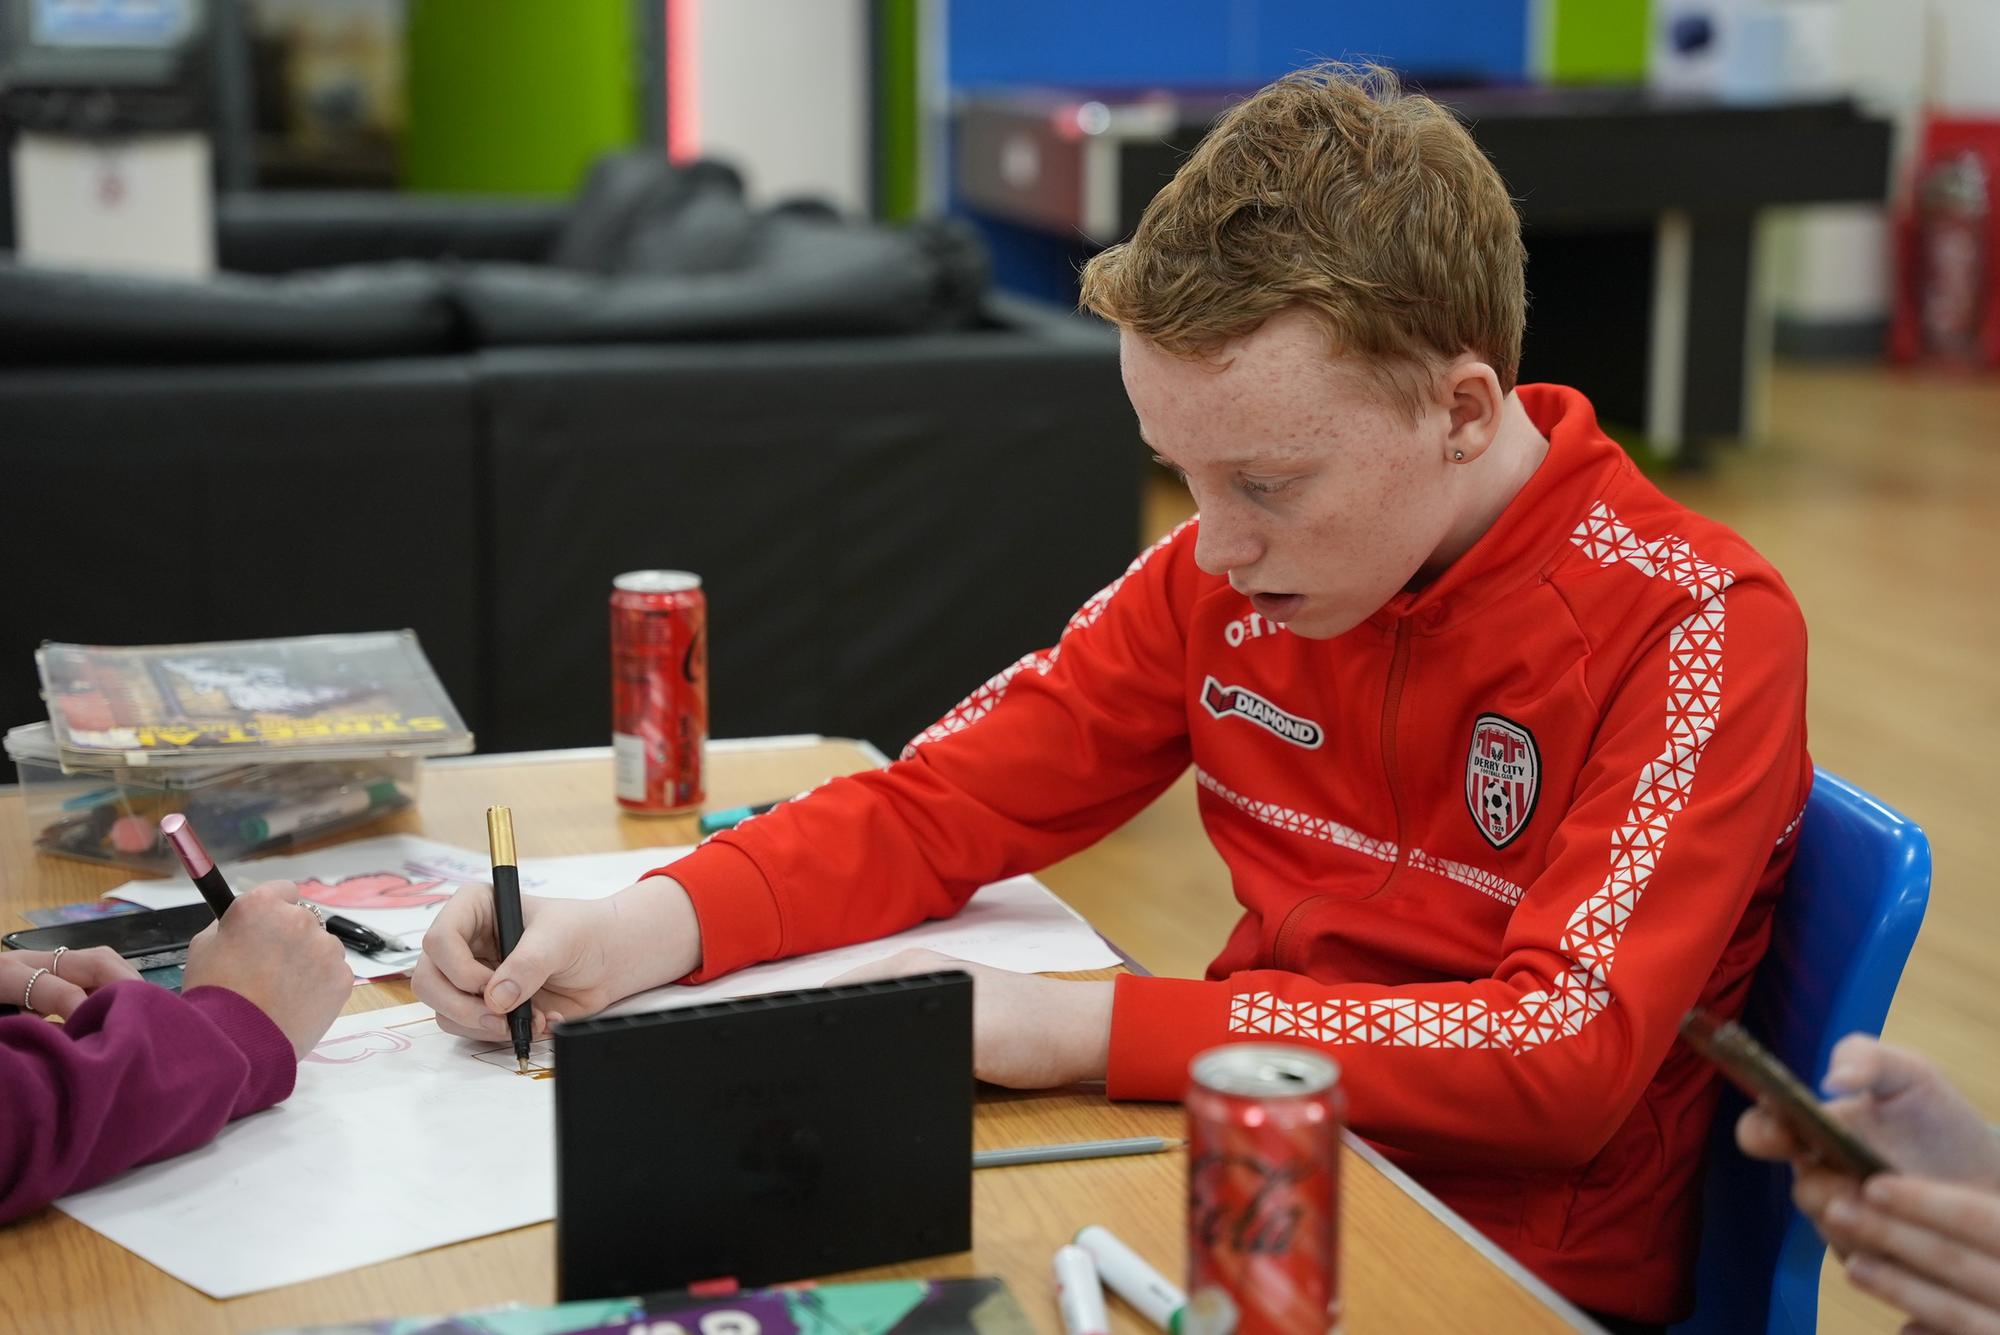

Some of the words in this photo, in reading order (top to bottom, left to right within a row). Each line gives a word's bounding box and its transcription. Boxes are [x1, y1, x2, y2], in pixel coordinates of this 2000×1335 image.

[1234, 692, 1315, 742] DIAMOND
[1474, 755, 1500, 772] DERRY
[1502, 763, 1525, 777] CITY
